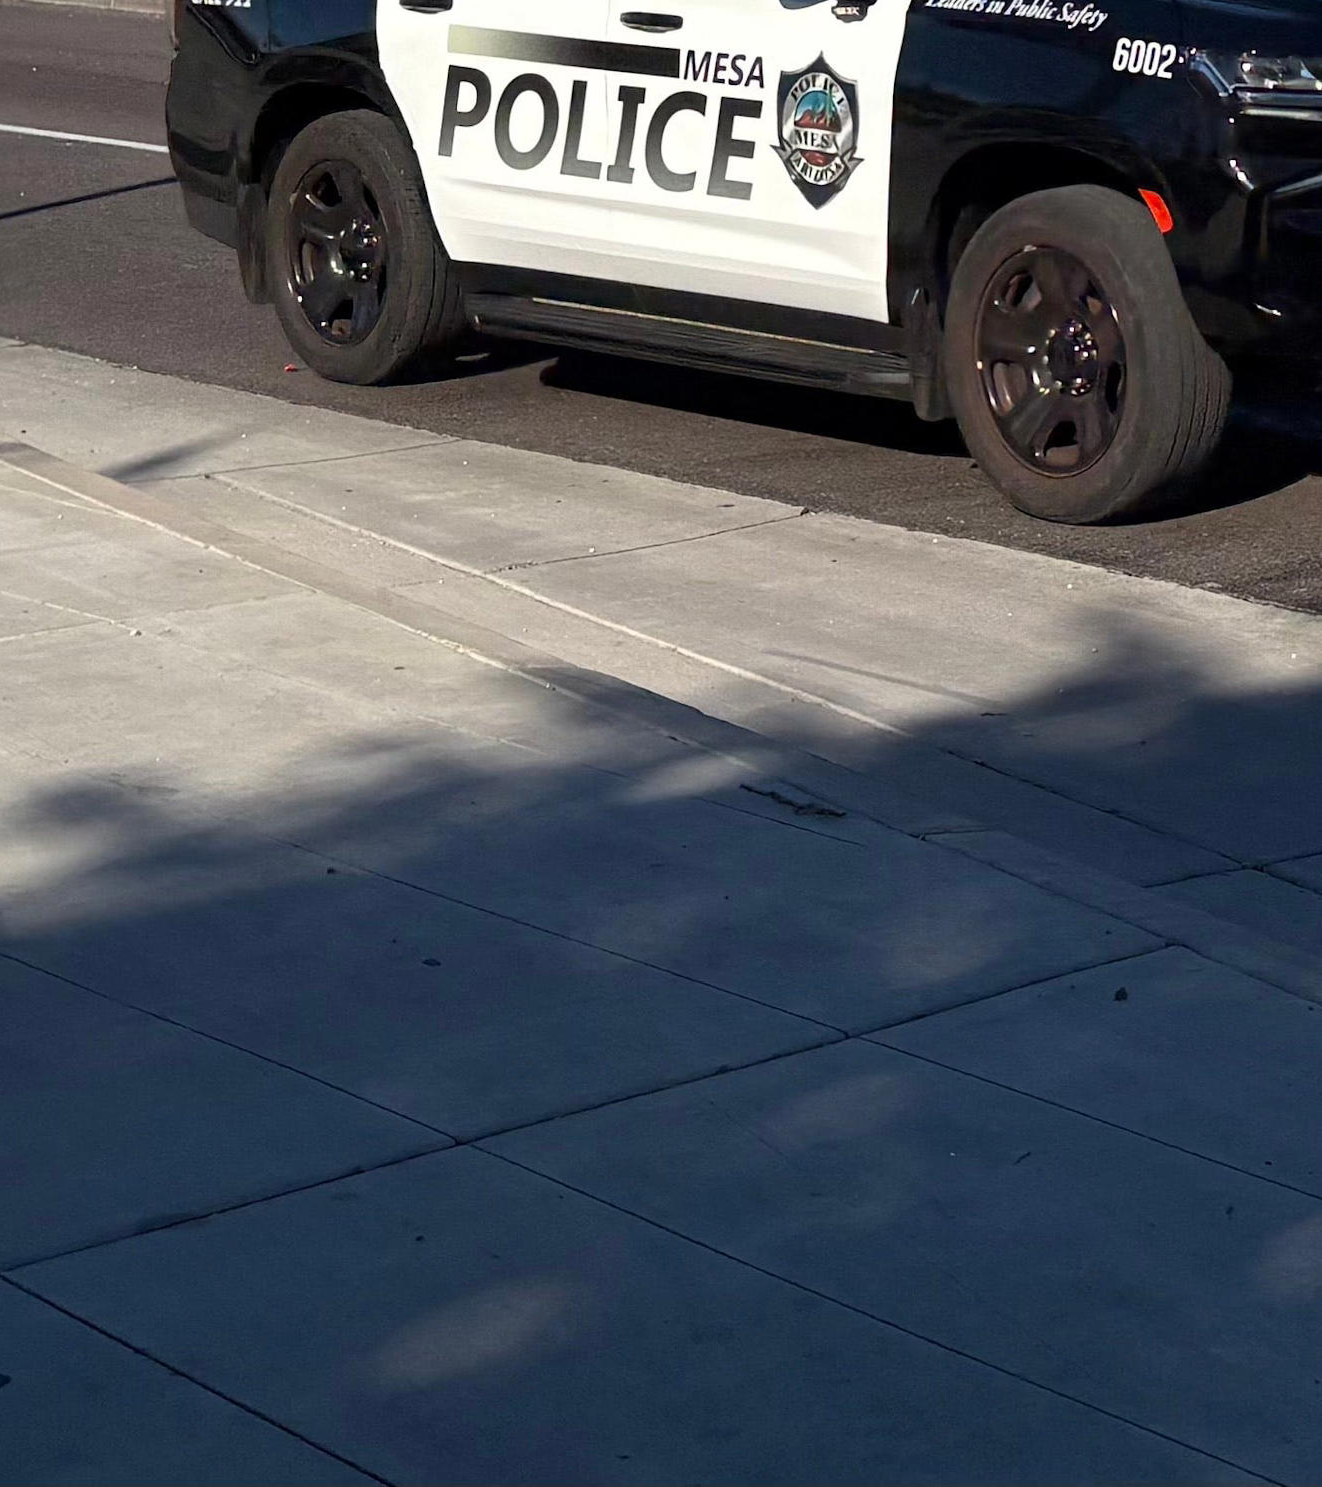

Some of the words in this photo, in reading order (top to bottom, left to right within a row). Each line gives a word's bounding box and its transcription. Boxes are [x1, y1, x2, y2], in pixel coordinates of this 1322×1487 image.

[1057, 1, 1108, 32] Safety
[683, 49, 765, 89] MESA
[1112, 37, 1177, 79] 6002
[438, 64, 763, 200] POLICE
